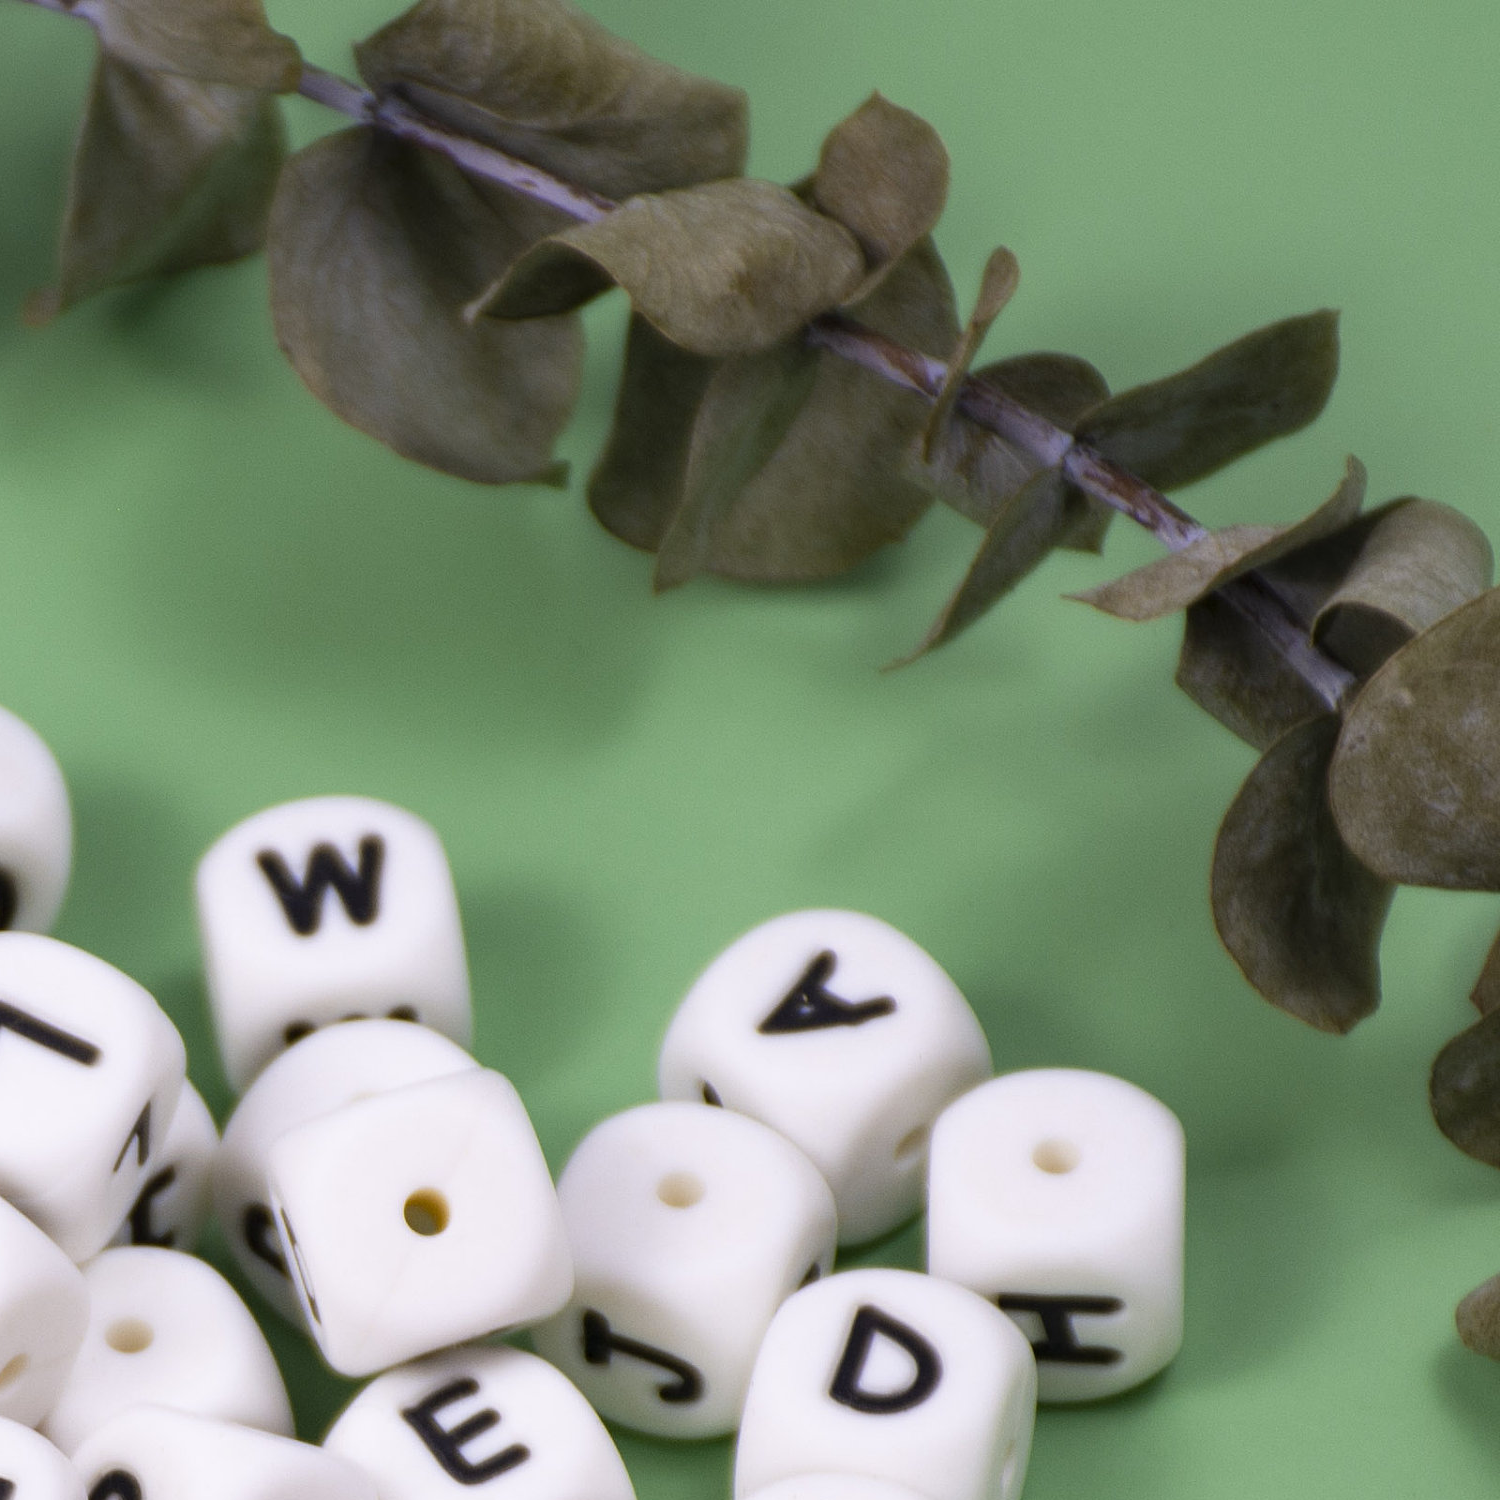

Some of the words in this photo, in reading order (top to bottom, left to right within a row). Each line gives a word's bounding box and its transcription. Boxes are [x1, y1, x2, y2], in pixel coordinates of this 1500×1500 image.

[255, 833, 386, 938] W
[756, 948, 898, 1035] A
[578, 1306, 704, 1405] J
[828, 1305, 940, 1415] D
[991, 1291, 1124, 1367] H
[402, 1376, 528, 1486] E
